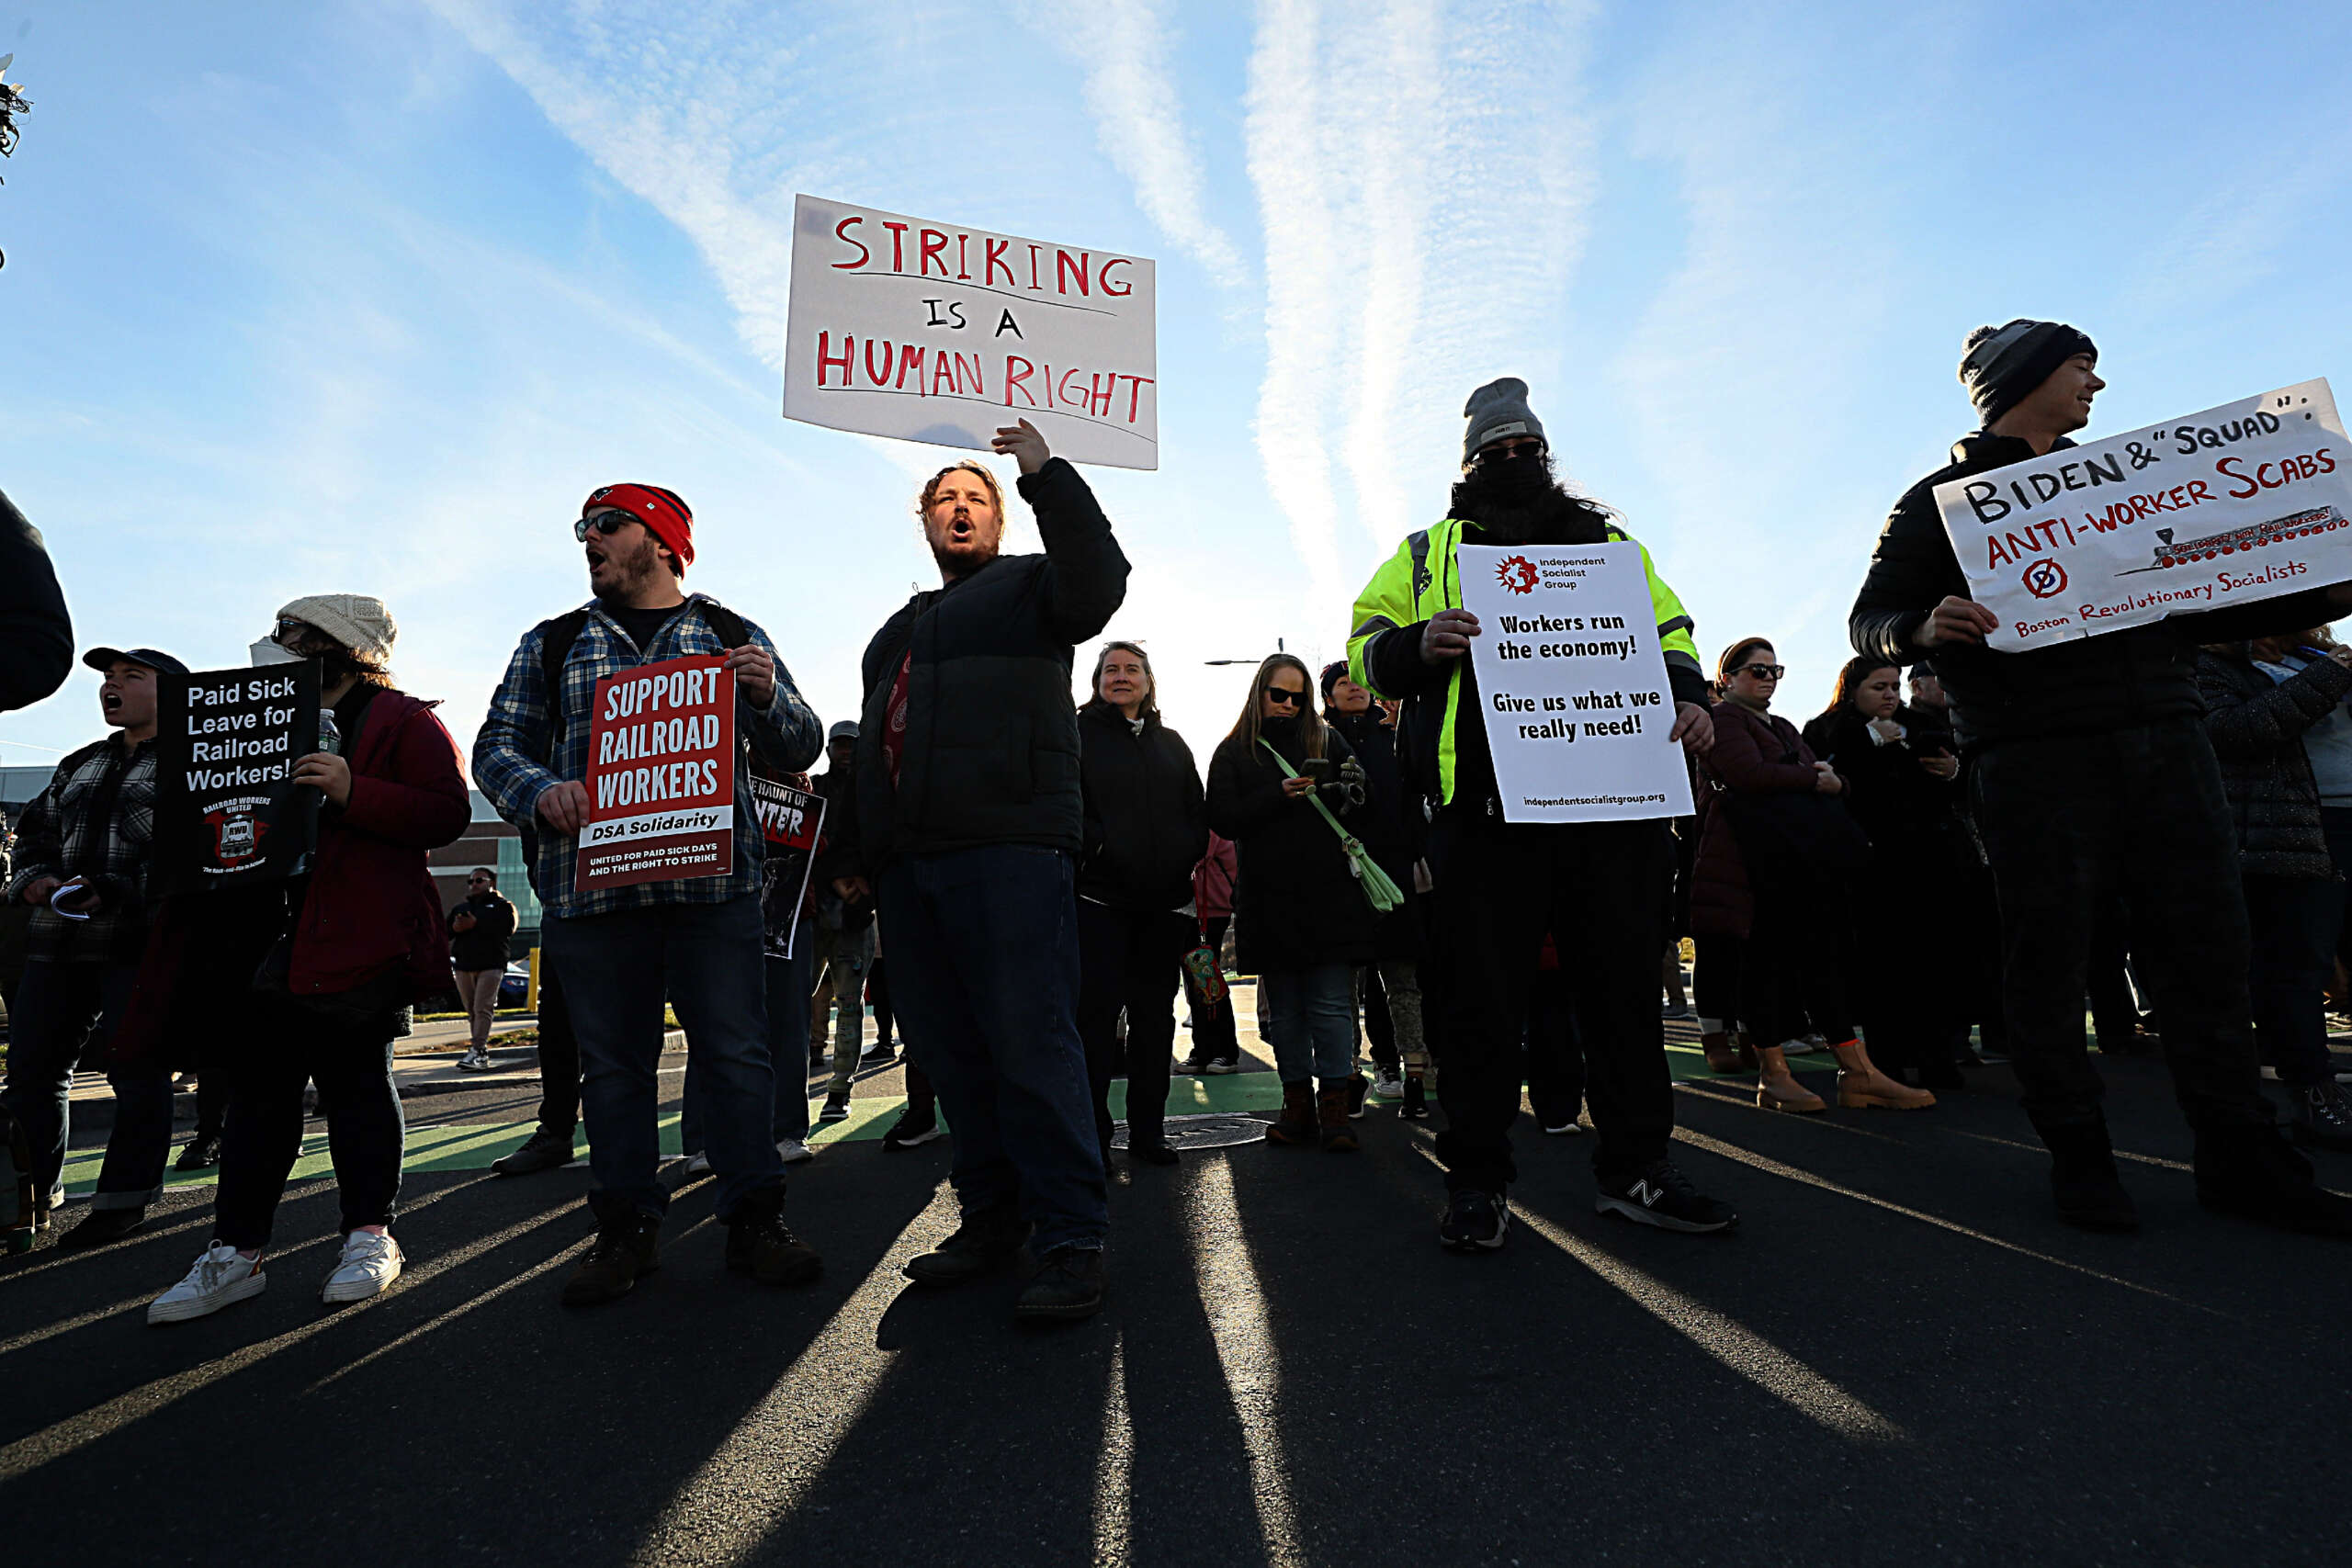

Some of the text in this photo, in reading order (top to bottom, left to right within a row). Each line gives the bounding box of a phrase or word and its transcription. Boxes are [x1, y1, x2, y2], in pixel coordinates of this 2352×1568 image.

[831, 217, 1132, 296] STRIKING
[922, 299, 1023, 339] IS A
[817, 331, 1154, 423] HUMAN RIGHT
[1963, 453, 2126, 525] BIDEN
[2125, 442, 2161, 470] &
[1988, 448, 2335, 570] ANTI-WORKER SCABS
[2173, 535, 2232, 555] SOLIDARITY
[2259, 524, 2284, 535] RAIL
[1539, 558, 1606, 567] Independent
[1542, 570, 1587, 578] Socialist
[1544, 581, 1577, 590] Group
[2015, 560, 2308, 637] Boston Revolutionary Socialists
[1499, 615, 1624, 633] Workers run
[1498, 636, 1637, 660] the economy!
[188, 677, 295, 707] Paid Sick
[605, 668, 721, 721] SUPPORT
[1493, 691, 1661, 712] Give us what we
[187, 705, 295, 736] Leave for
[1519, 714, 1642, 742] really need!
[192, 731, 288, 762] Railroad
[599, 715, 719, 765] RAILROAD
[187, 758, 290, 792] Workers!
[597, 759, 718, 809] WORKERS
[203, 796, 271, 814] RAILROAD WORKERS
[758, 782, 794, 803] HAUNT
[795, 794, 808, 807] OF
[1523, 794, 1665, 808] independentsocialistgroup.org
[226, 804, 252, 814] UNITED
[229, 826, 248, 836] RWU
[592, 812, 719, 840] DSA Solidarity
[589, 853, 718, 877] AND THE RIGHT TO STRIKE
[590, 843, 718, 866] UNITED FOR PAID SICK DAYS
